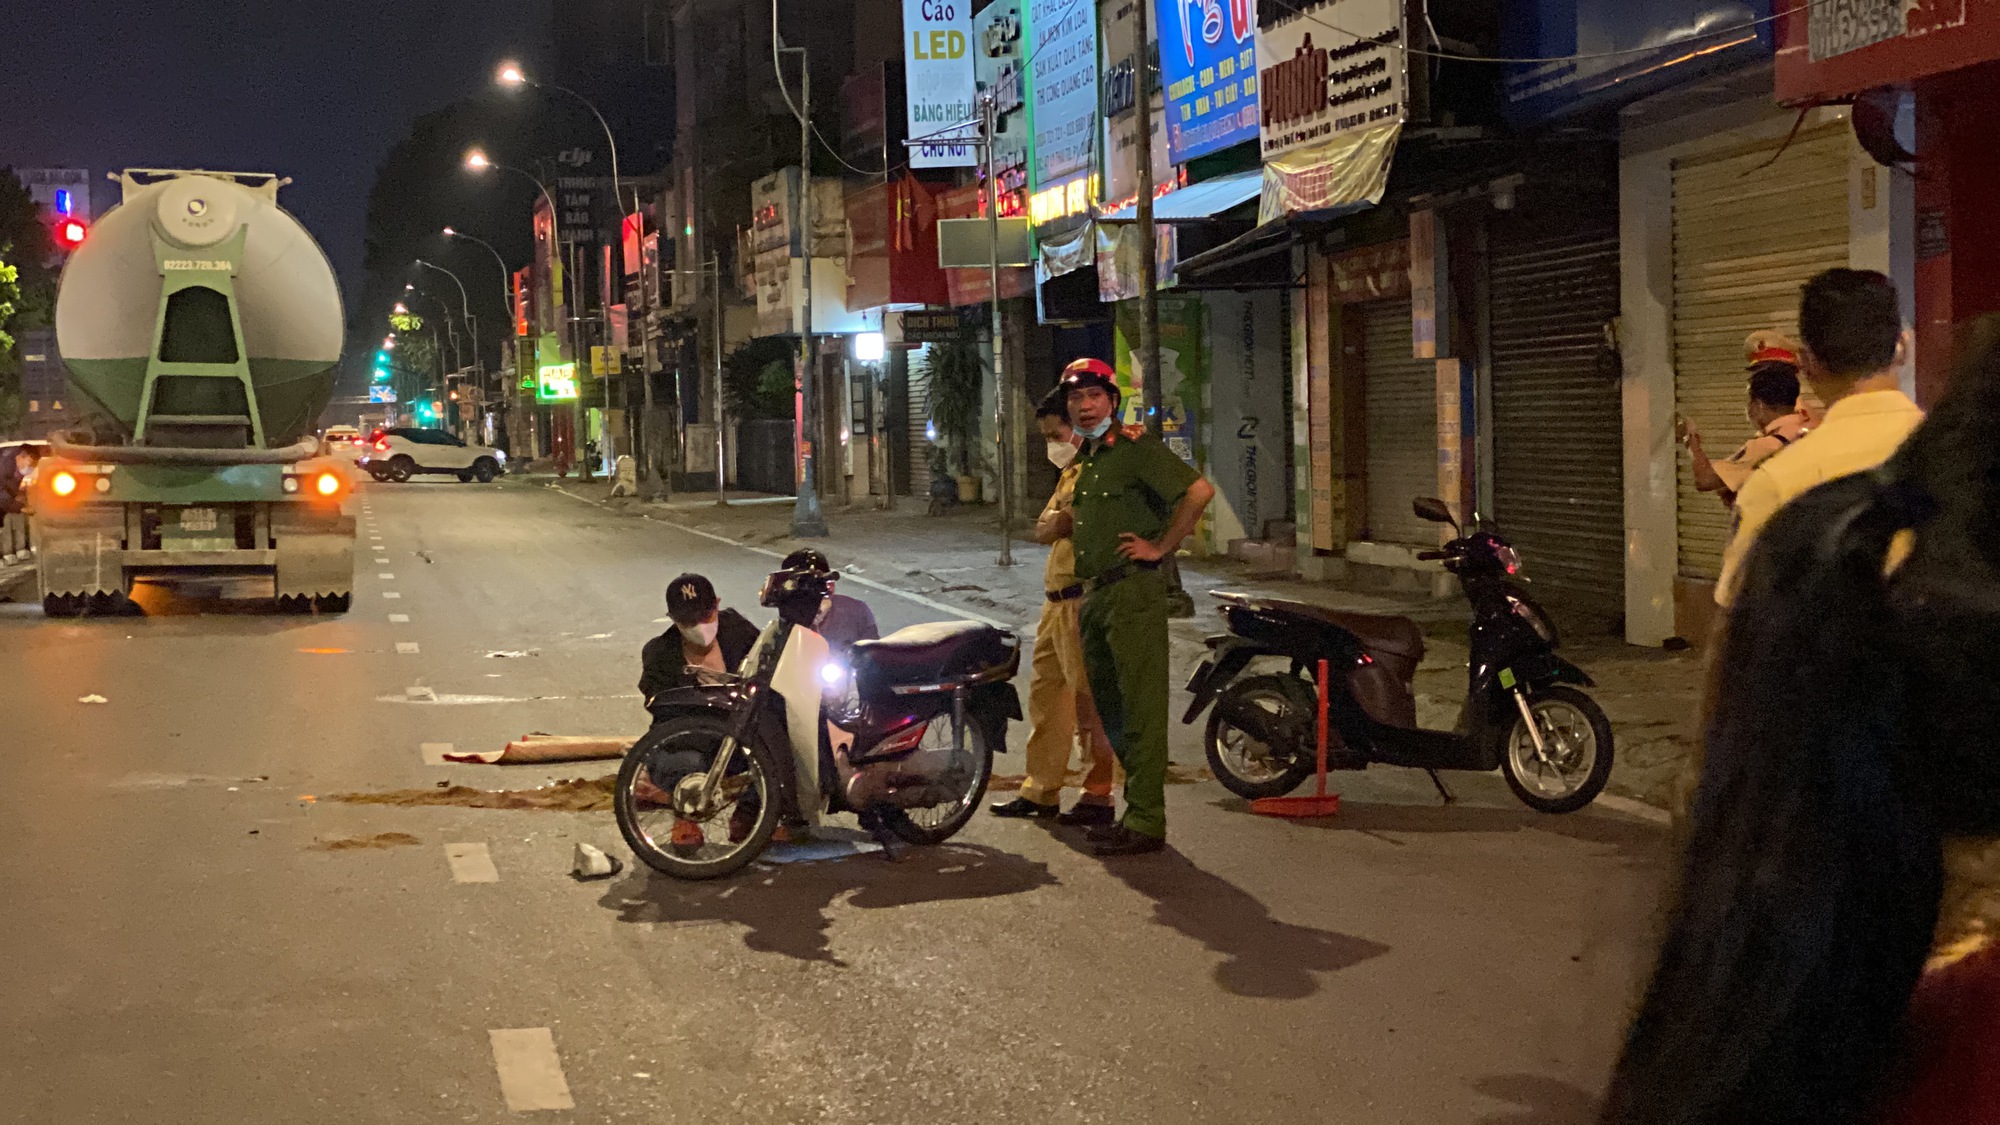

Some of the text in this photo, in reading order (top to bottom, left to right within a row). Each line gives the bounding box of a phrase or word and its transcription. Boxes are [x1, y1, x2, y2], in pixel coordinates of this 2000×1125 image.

[921, 0, 955, 21] Cáo
[913, 30, 966, 60] LED
[1240, 47, 1254, 71] GIFT
[914, 97, 943, 122] BẢNG
[681, 583, 697, 600] NY
